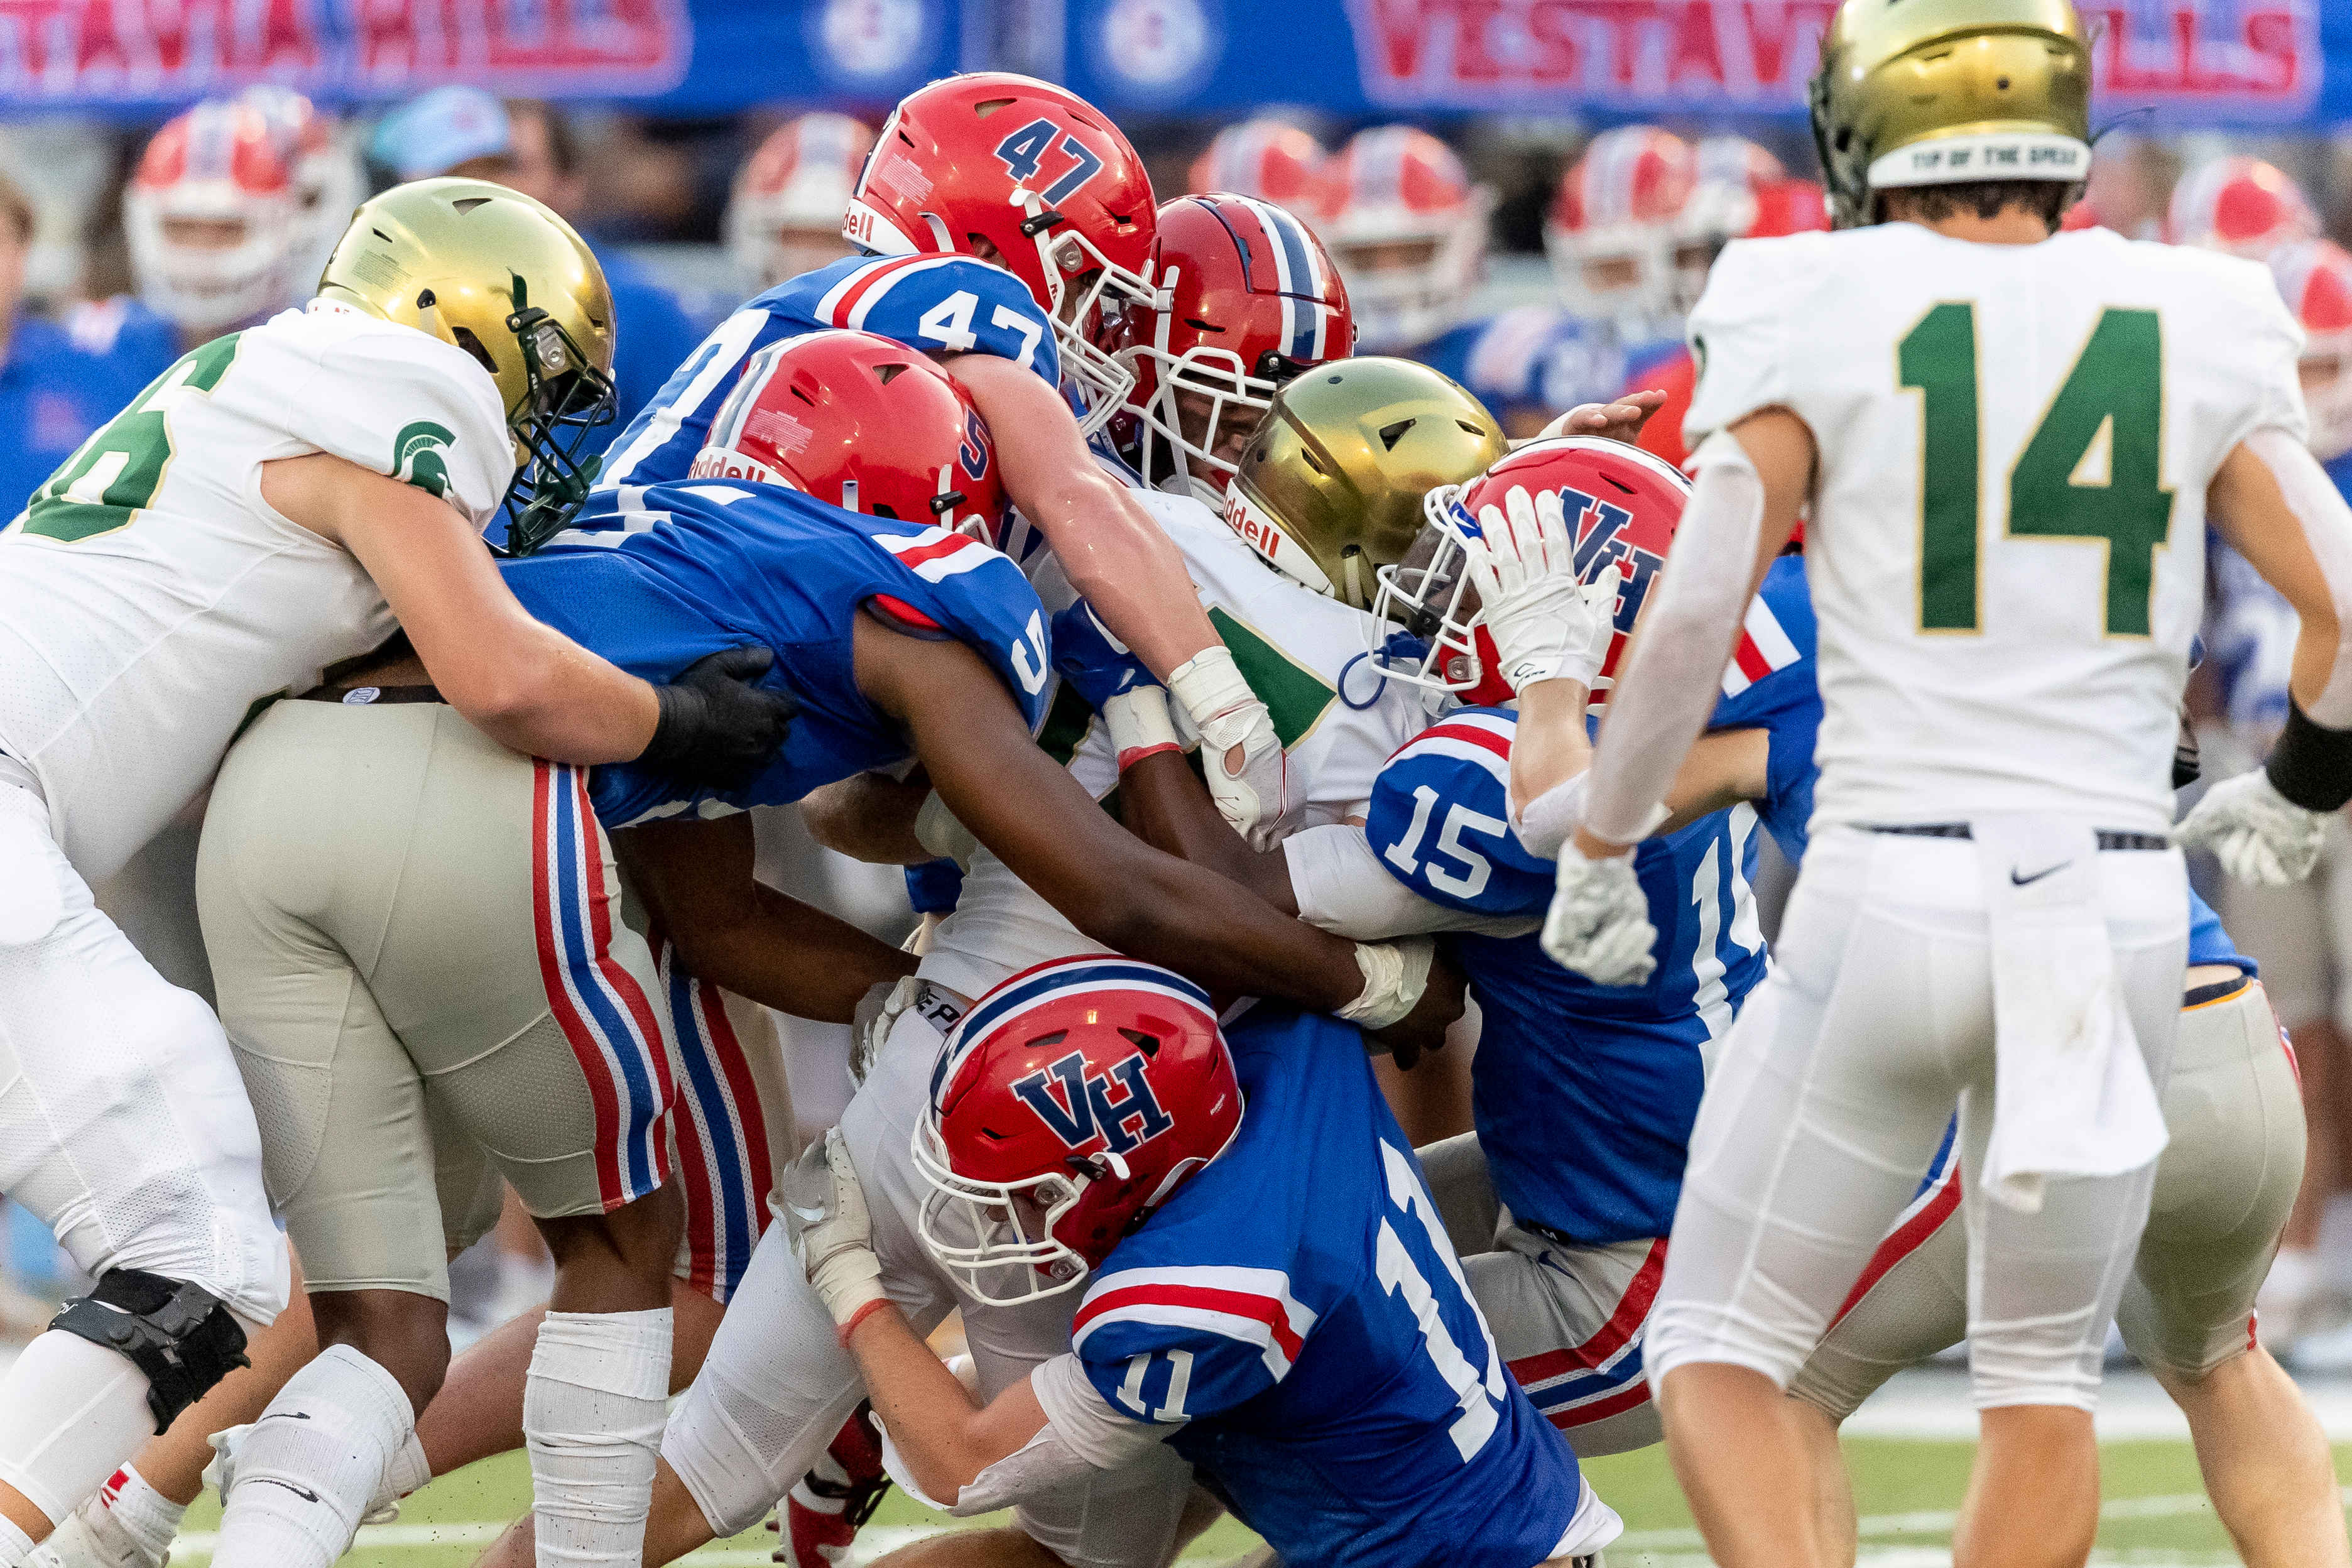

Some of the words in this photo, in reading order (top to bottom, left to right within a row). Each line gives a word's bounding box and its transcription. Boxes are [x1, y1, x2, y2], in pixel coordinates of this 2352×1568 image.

[993, 117, 1105, 210] 47
[918, 290, 1043, 369] 47
[1892, 298, 2180, 641] 14
[1224, 494, 1280, 558] ddell
[1383, 784, 1508, 900] 15
[1008, 1048, 1175, 1157] VH
[1376, 1136, 1508, 1465] 11
[1116, 1348, 1195, 1424] 11
